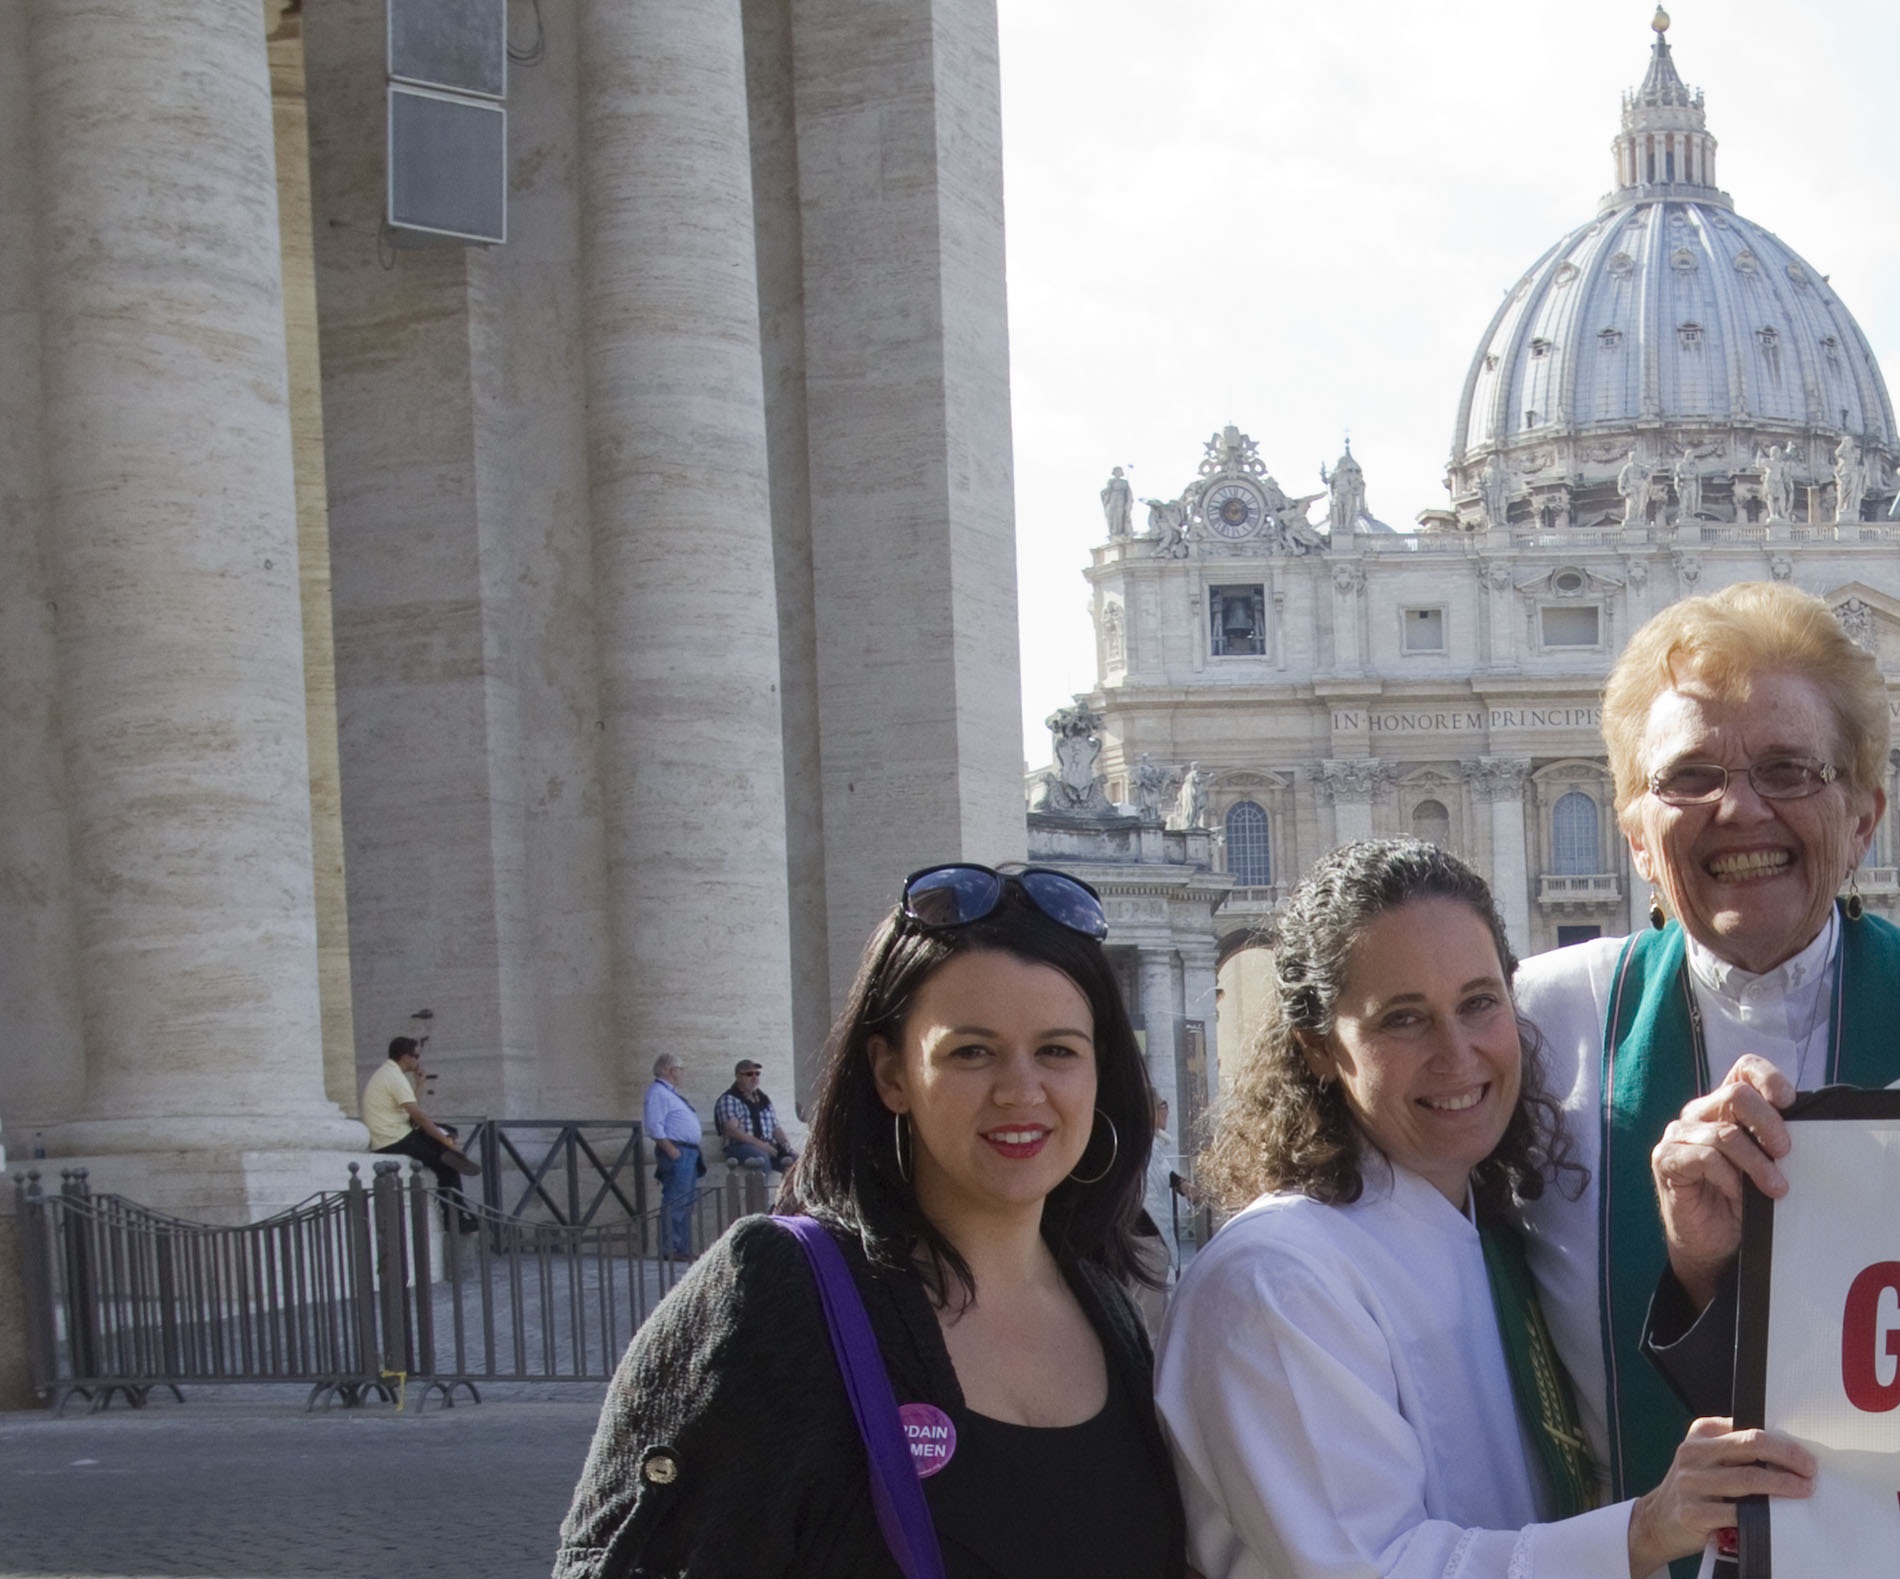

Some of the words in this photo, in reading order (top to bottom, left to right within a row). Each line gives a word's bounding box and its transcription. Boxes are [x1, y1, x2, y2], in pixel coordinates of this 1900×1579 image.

[1333, 713, 1359, 730] IN
[1369, 711, 1482, 731] HONOREM
[904, 1424, 948, 1440] DAIN
[910, 1443, 946, 1458] MEN
